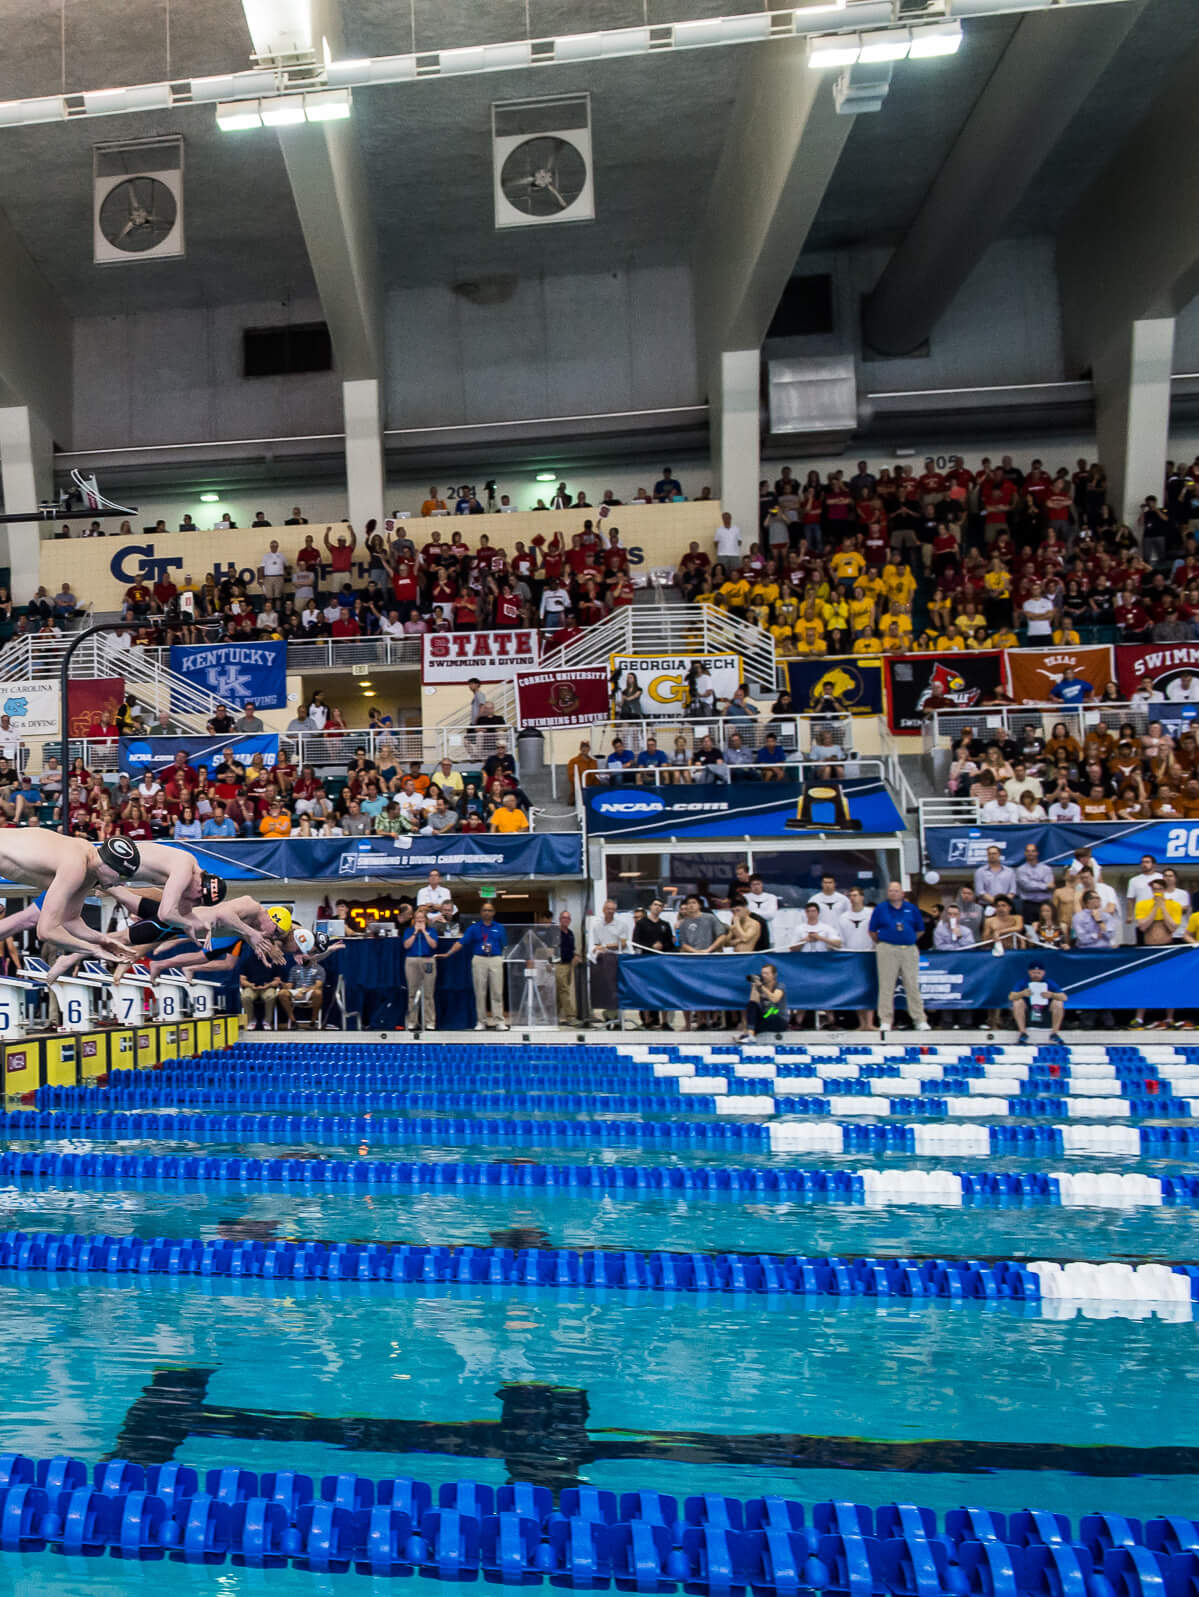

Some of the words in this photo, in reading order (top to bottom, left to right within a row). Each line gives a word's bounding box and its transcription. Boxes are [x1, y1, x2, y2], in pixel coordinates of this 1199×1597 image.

[110, 544, 183, 585] GT
[430, 632, 532, 657] STATE
[182, 648, 276, 672] KENTUCKY
[429, 658, 486, 668] SWIMMING
[498, 656, 534, 666] DIVING
[619, 660, 686, 671] GEORGIA
[703, 658, 735, 669] ECH
[205, 665, 252, 697] UK
[519, 673, 555, 687] CORNELL
[556, 671, 607, 682] UNIVERSITY
[10, 683, 53, 694] CAROLINA
[28, 720, 57, 729] DIVING
[521, 716, 570, 727] SWIMMING
[600, 801, 729, 812] NCAA.com
[68, 1000, 81, 1023] 6
[122, 998, 134, 1019] 7
[163, 996, 174, 1015] 8
[196, 996, 206, 1012] 9
